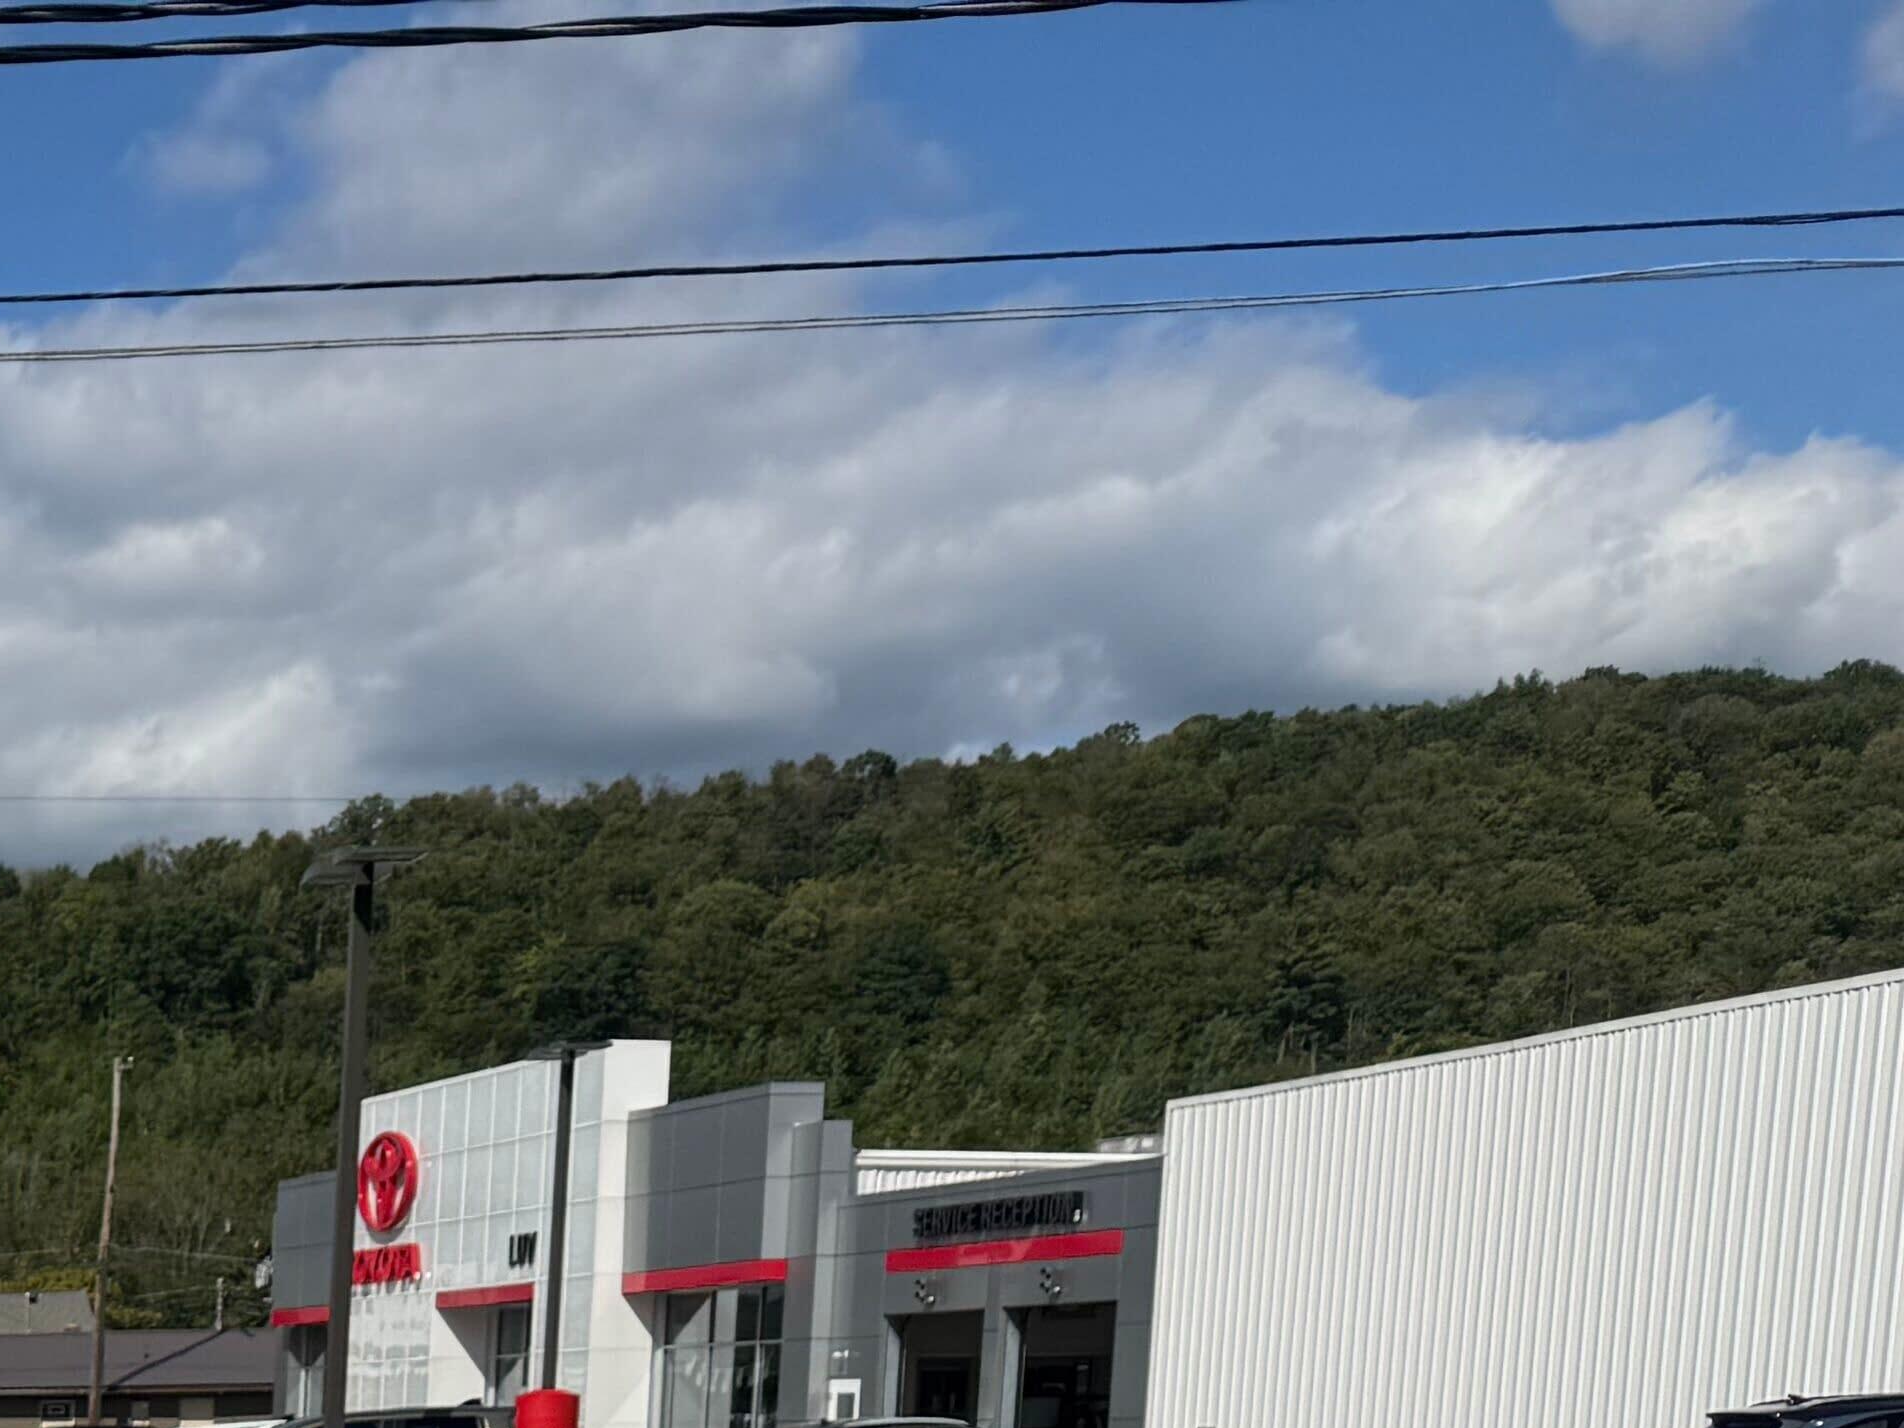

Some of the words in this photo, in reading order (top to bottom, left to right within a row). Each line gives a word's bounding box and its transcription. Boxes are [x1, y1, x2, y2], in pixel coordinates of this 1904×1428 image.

[913, 1203, 977, 1238] SERVICE
[979, 1191, 1084, 1233] RECEPTION
[509, 1231, 538, 1269] LUV
